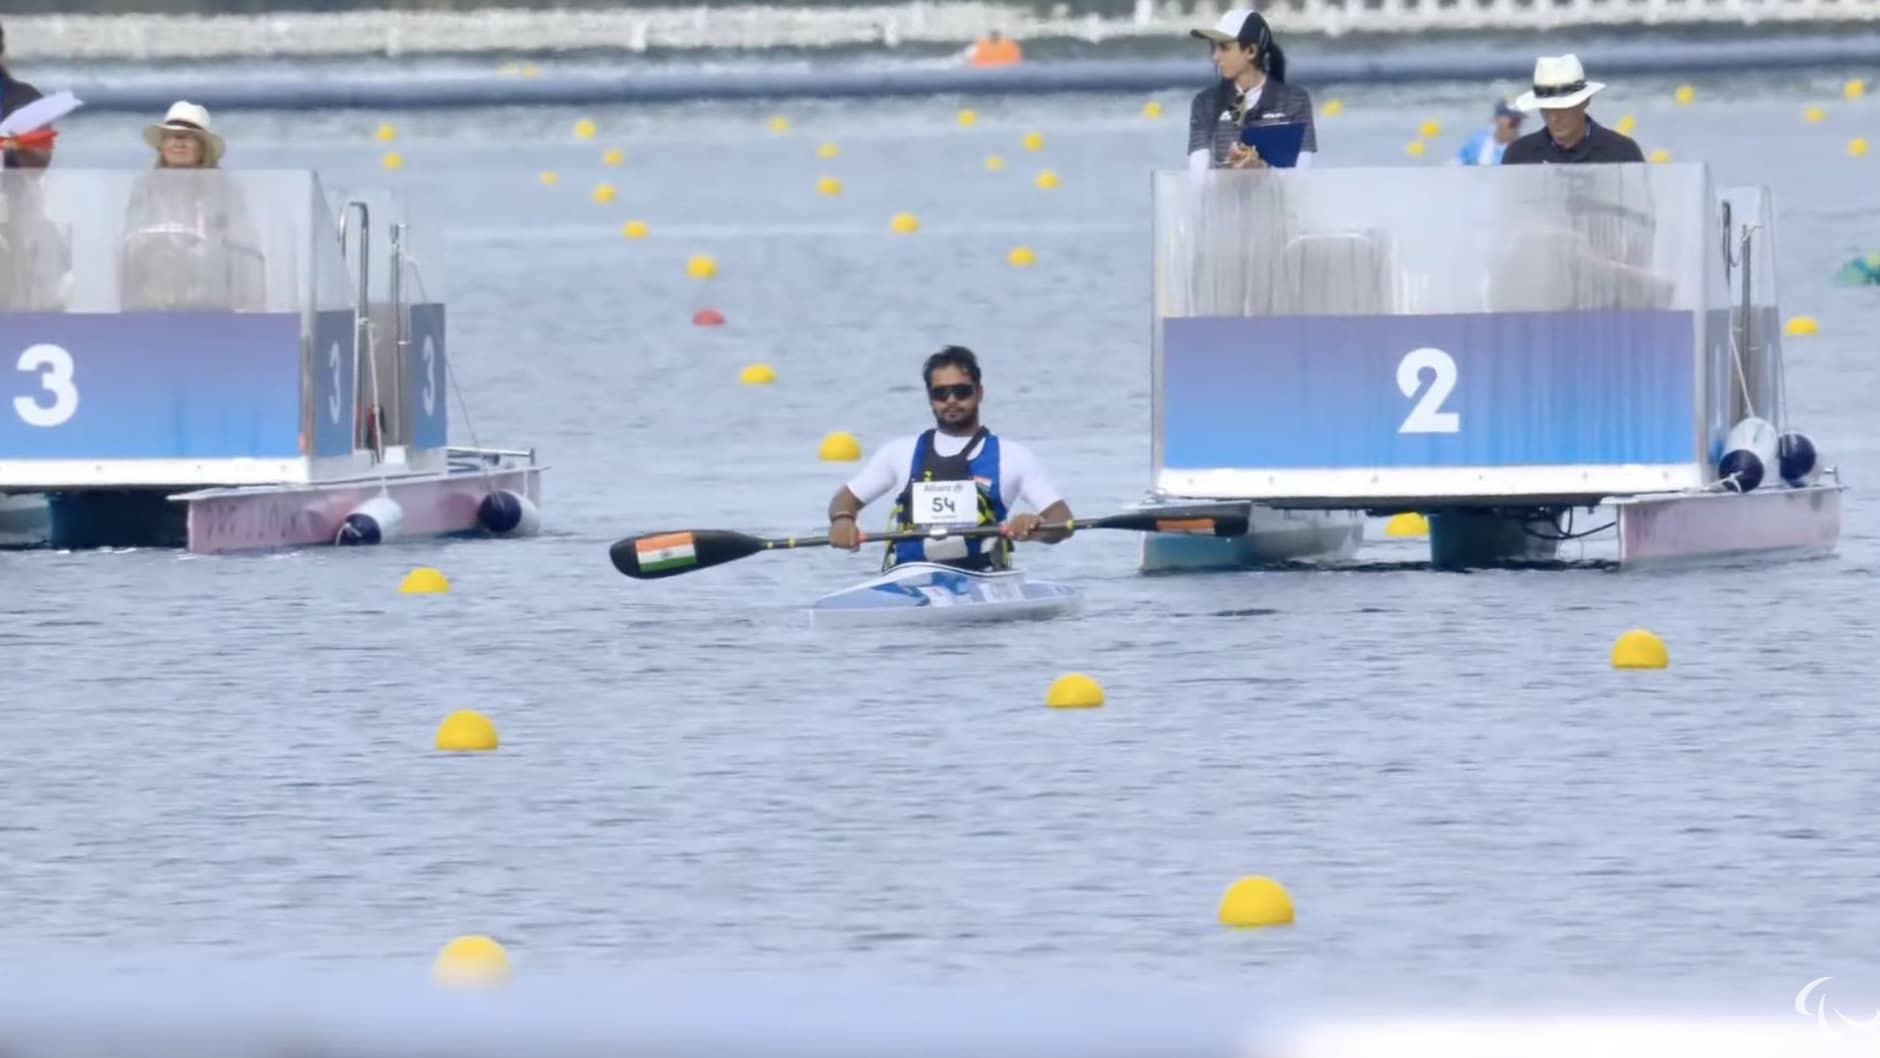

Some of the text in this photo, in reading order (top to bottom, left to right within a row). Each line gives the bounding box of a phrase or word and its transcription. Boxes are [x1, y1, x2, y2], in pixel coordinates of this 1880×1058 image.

[13, 343, 79, 427] 3
[328, 341, 341, 425] 3
[422, 335, 435, 417] 3
[1396, 347, 1460, 434] 2
[931, 496, 955, 513] 54
